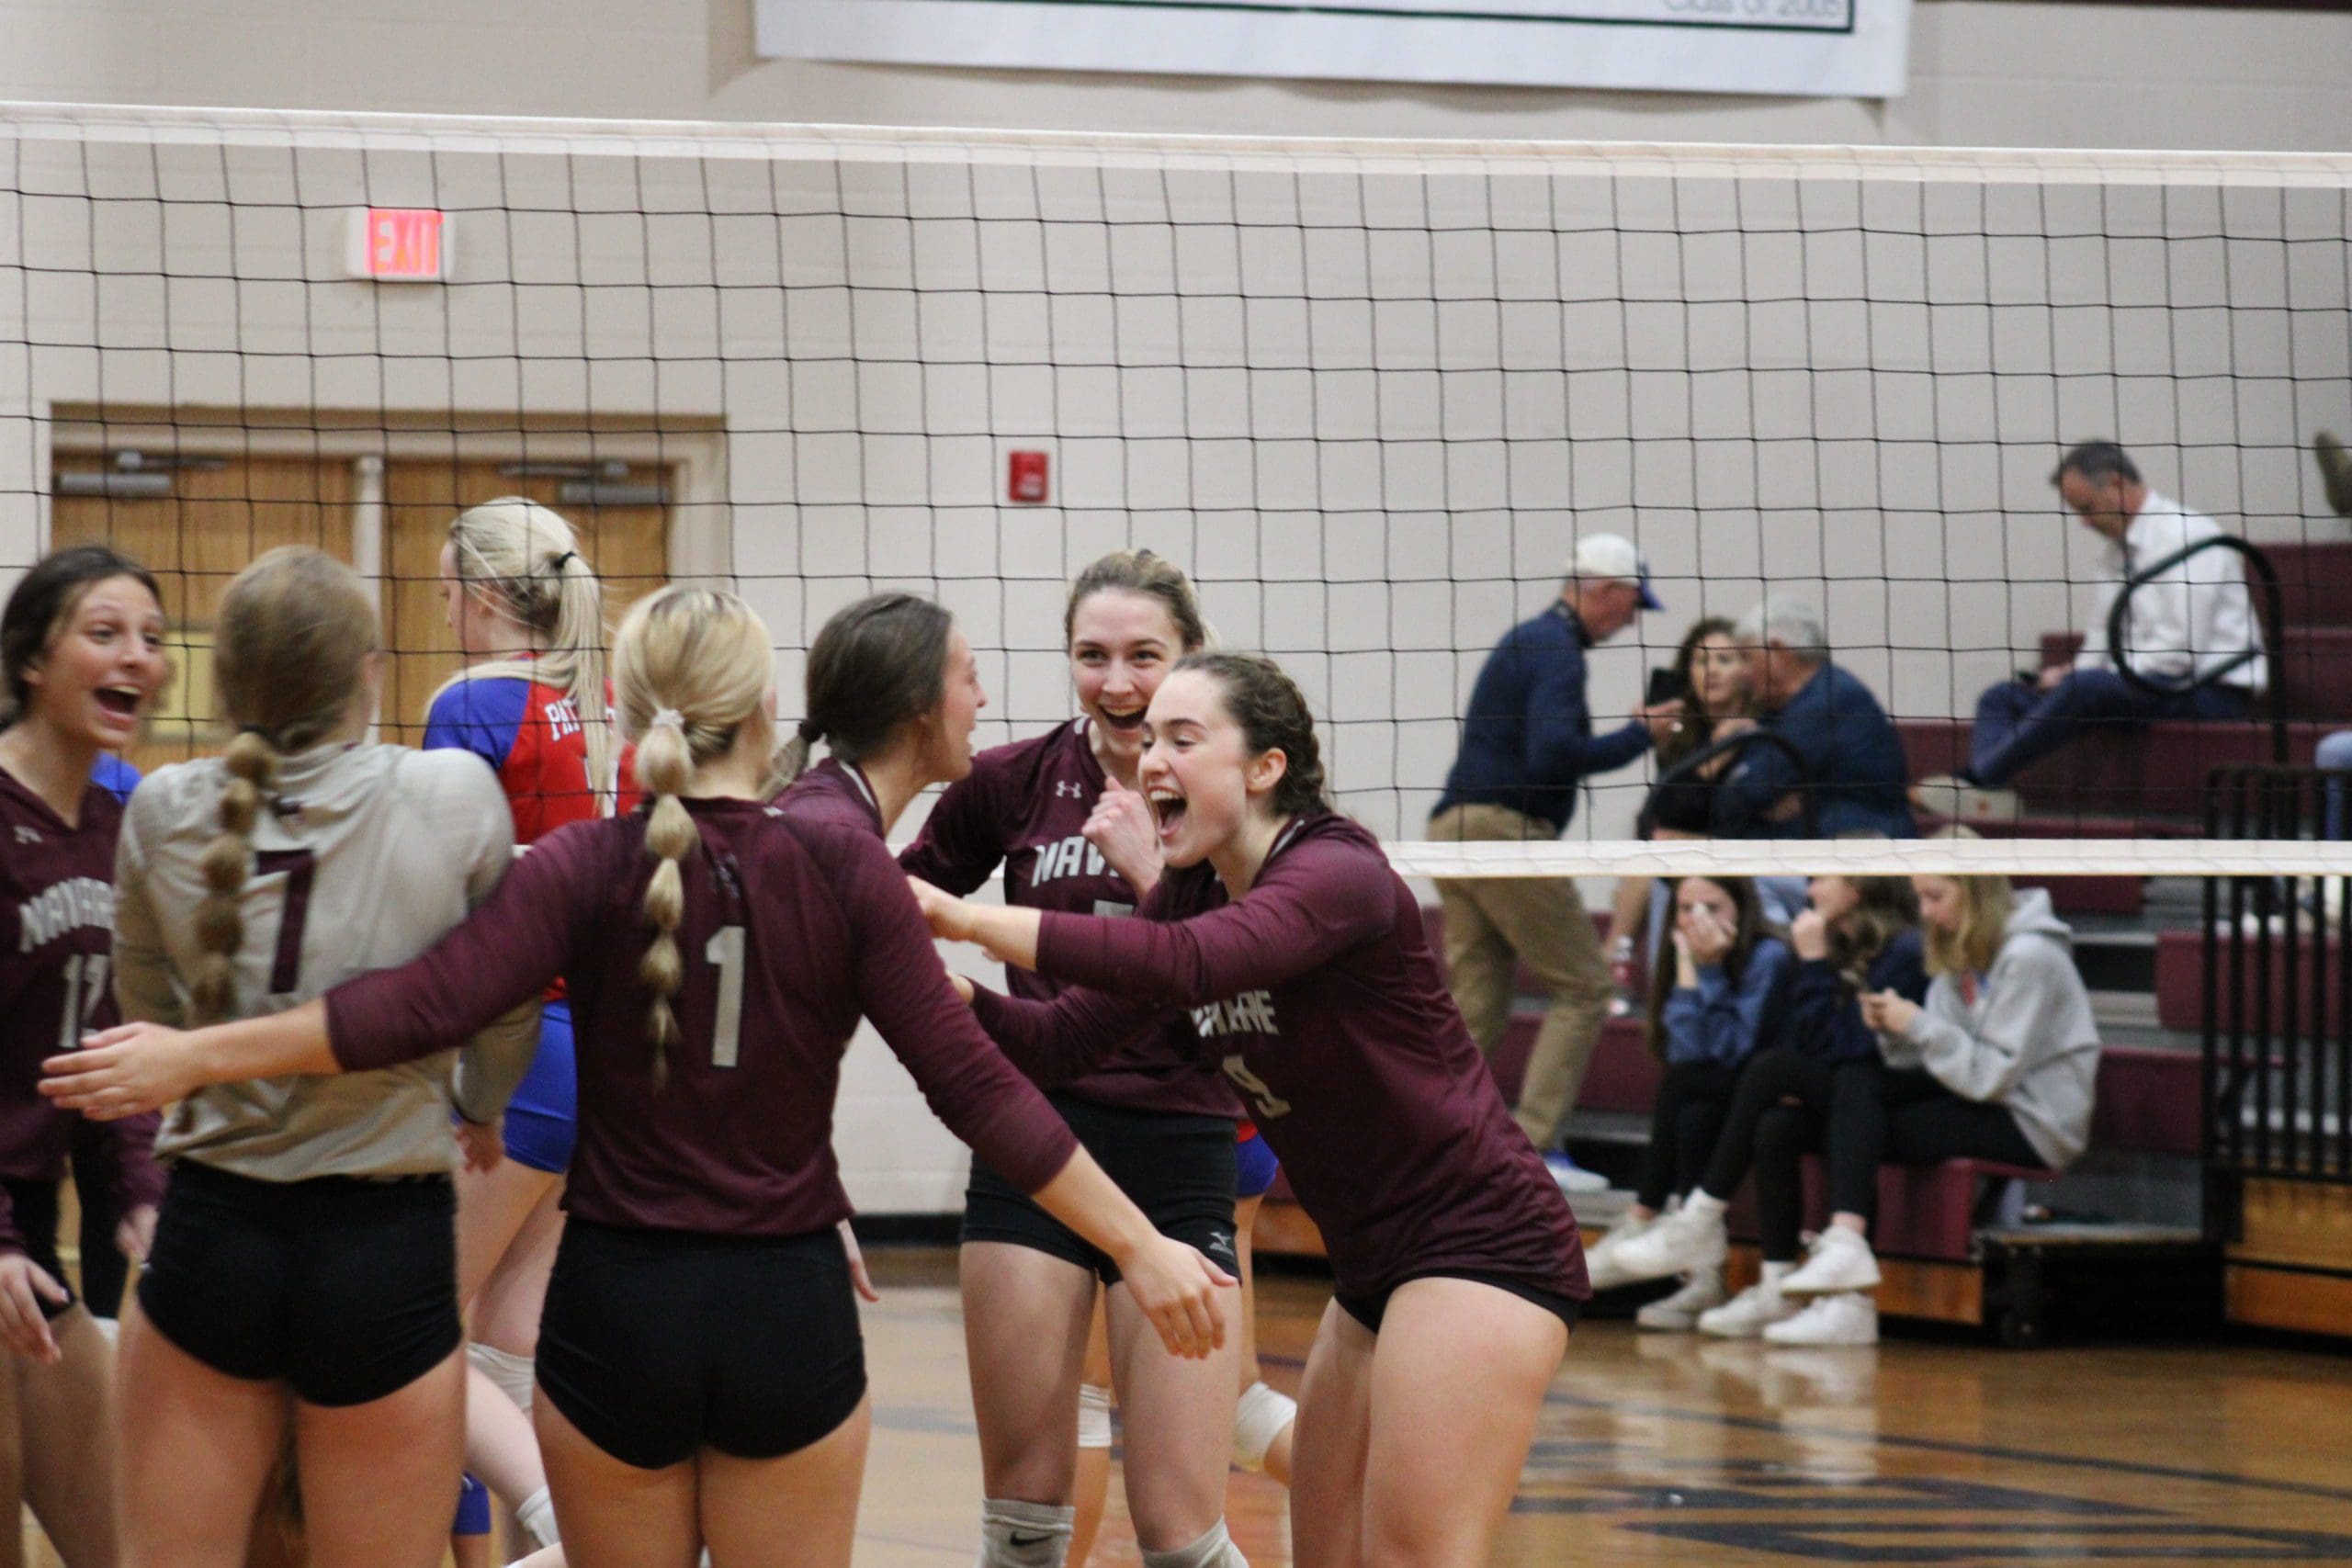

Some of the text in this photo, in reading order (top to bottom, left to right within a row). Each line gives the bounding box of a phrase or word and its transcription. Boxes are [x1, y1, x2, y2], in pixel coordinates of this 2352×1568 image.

[368, 210, 441, 275] EXIT
[1031, 835, 1120, 888] NAV
[254, 849, 315, 995] 7
[706, 925, 746, 1068] 1
[1222, 1055, 1292, 1120] 9
